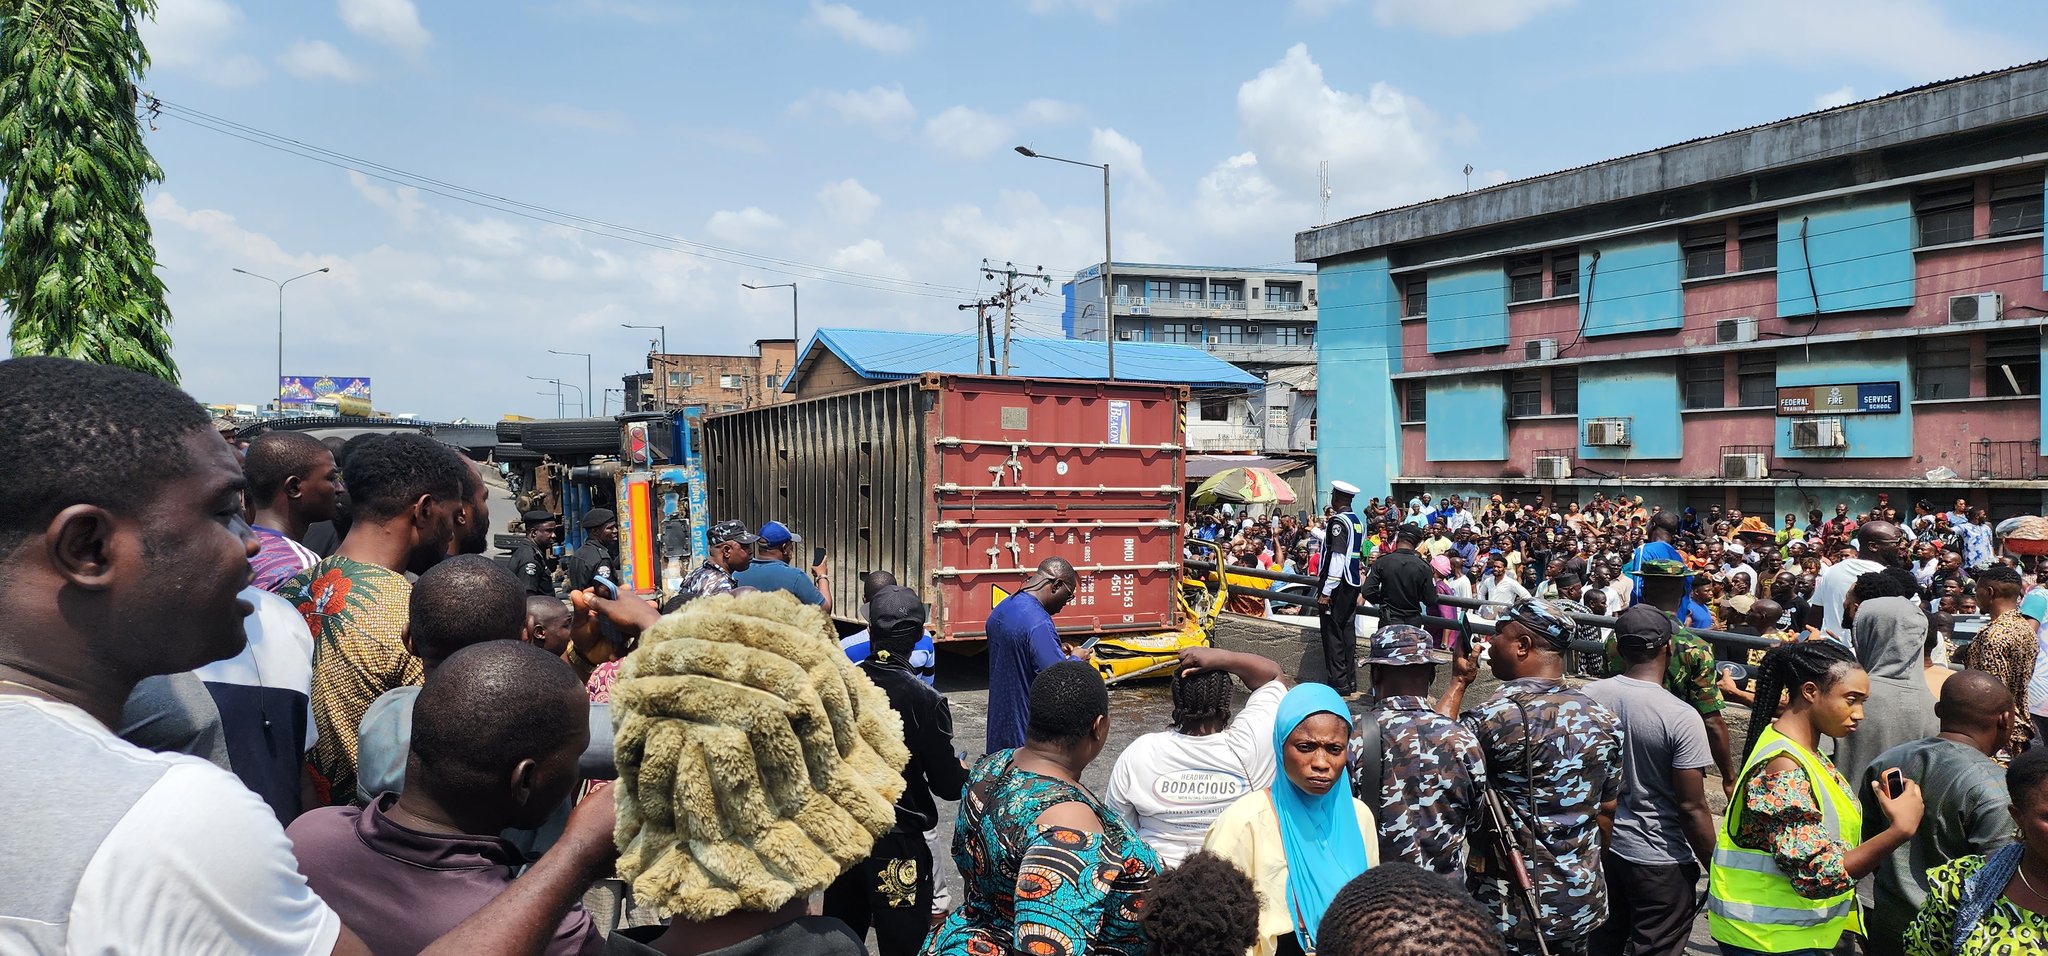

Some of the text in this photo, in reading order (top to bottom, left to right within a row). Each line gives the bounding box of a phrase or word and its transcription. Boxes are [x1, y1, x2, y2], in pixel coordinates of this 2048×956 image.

[1781, 395, 1892, 406] FEDERAL FIRE SERVICE
[1111, 406, 1121, 444] BEACON
[689, 479, 701, 502] HORN
[1111, 574, 1121, 596] 45G1
[1123, 538, 1134, 623] BMOU 531563 5
[1161, 781, 1236, 795] BODACIOUS
